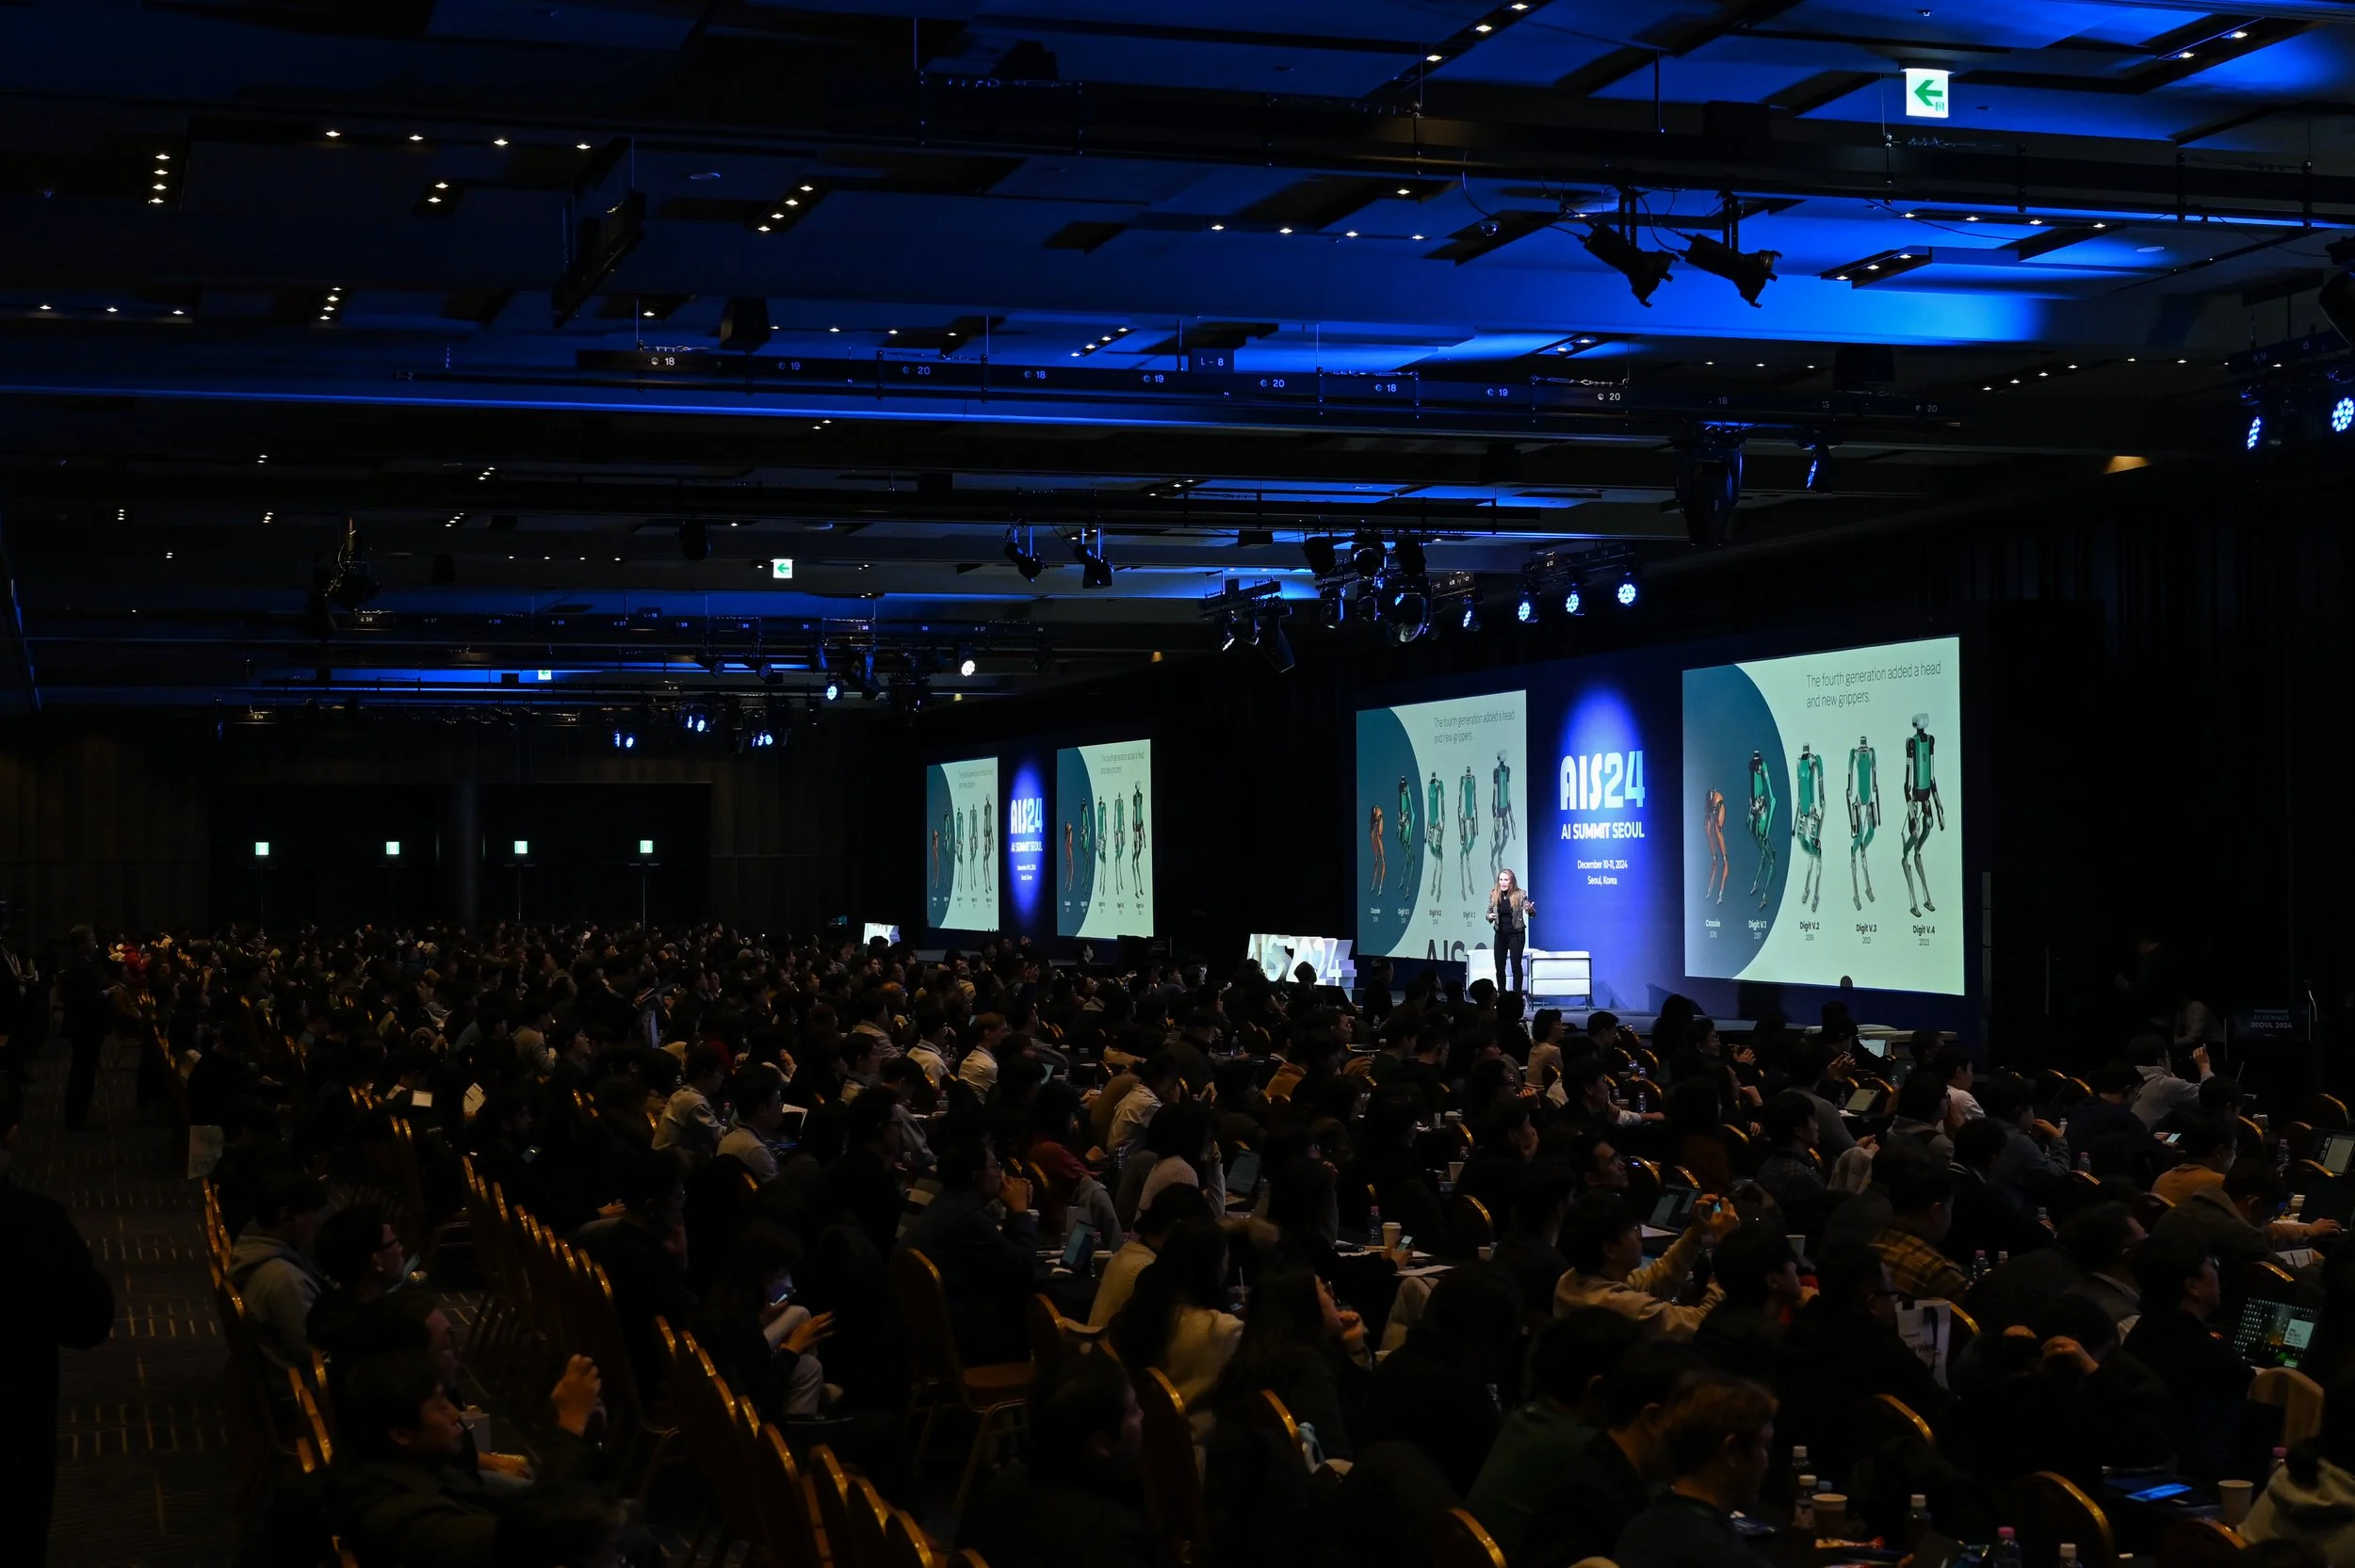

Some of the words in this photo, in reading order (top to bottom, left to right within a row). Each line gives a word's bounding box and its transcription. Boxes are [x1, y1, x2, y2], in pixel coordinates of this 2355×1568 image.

[664, 356, 675, 366] 18
[918, 365, 931, 375] 20
[1035, 370, 1046, 380] 18
[1273, 379, 1285, 388] 20
[1609, 392, 1621, 401] 20
[1807, 672, 1820, 688] The
[1821, 671, 1844, 687] fourth
[1845, 668, 1886, 688] generation
[1887, 665, 1912, 680] added
[1913, 668, 1919, 678] a
[1920, 660, 1941, 677] head
[1807, 695, 1820, 708] and
[1821, 696, 1837, 708] new
[1838, 691, 1870, 709] grippers.
[1560, 751, 1646, 811] AIS24
[1010, 798, 1043, 834] AIS24
[1561, 823, 1571, 840] AI
[1573, 821, 1611, 840] SUMMIT
[1612, 820, 1645, 839] SEOUL
[1577, 859, 1602, 869] December
[1616, 859, 1628, 869] 2024
[1587, 875, 1602, 886] Seoul,
[1603, 876, 1617, 885] Korea
[1748, 919, 1760, 931] Digit
[1799, 920, 1811, 932] Digit
[1811, 921, 1820, 930] V.2
[1856, 923, 1868, 935] Digit
[1868, 924, 1877, 933] V.3
[1912, 924, 1925, 937] Digit
[1926, 925, 1936, 934] V.4
